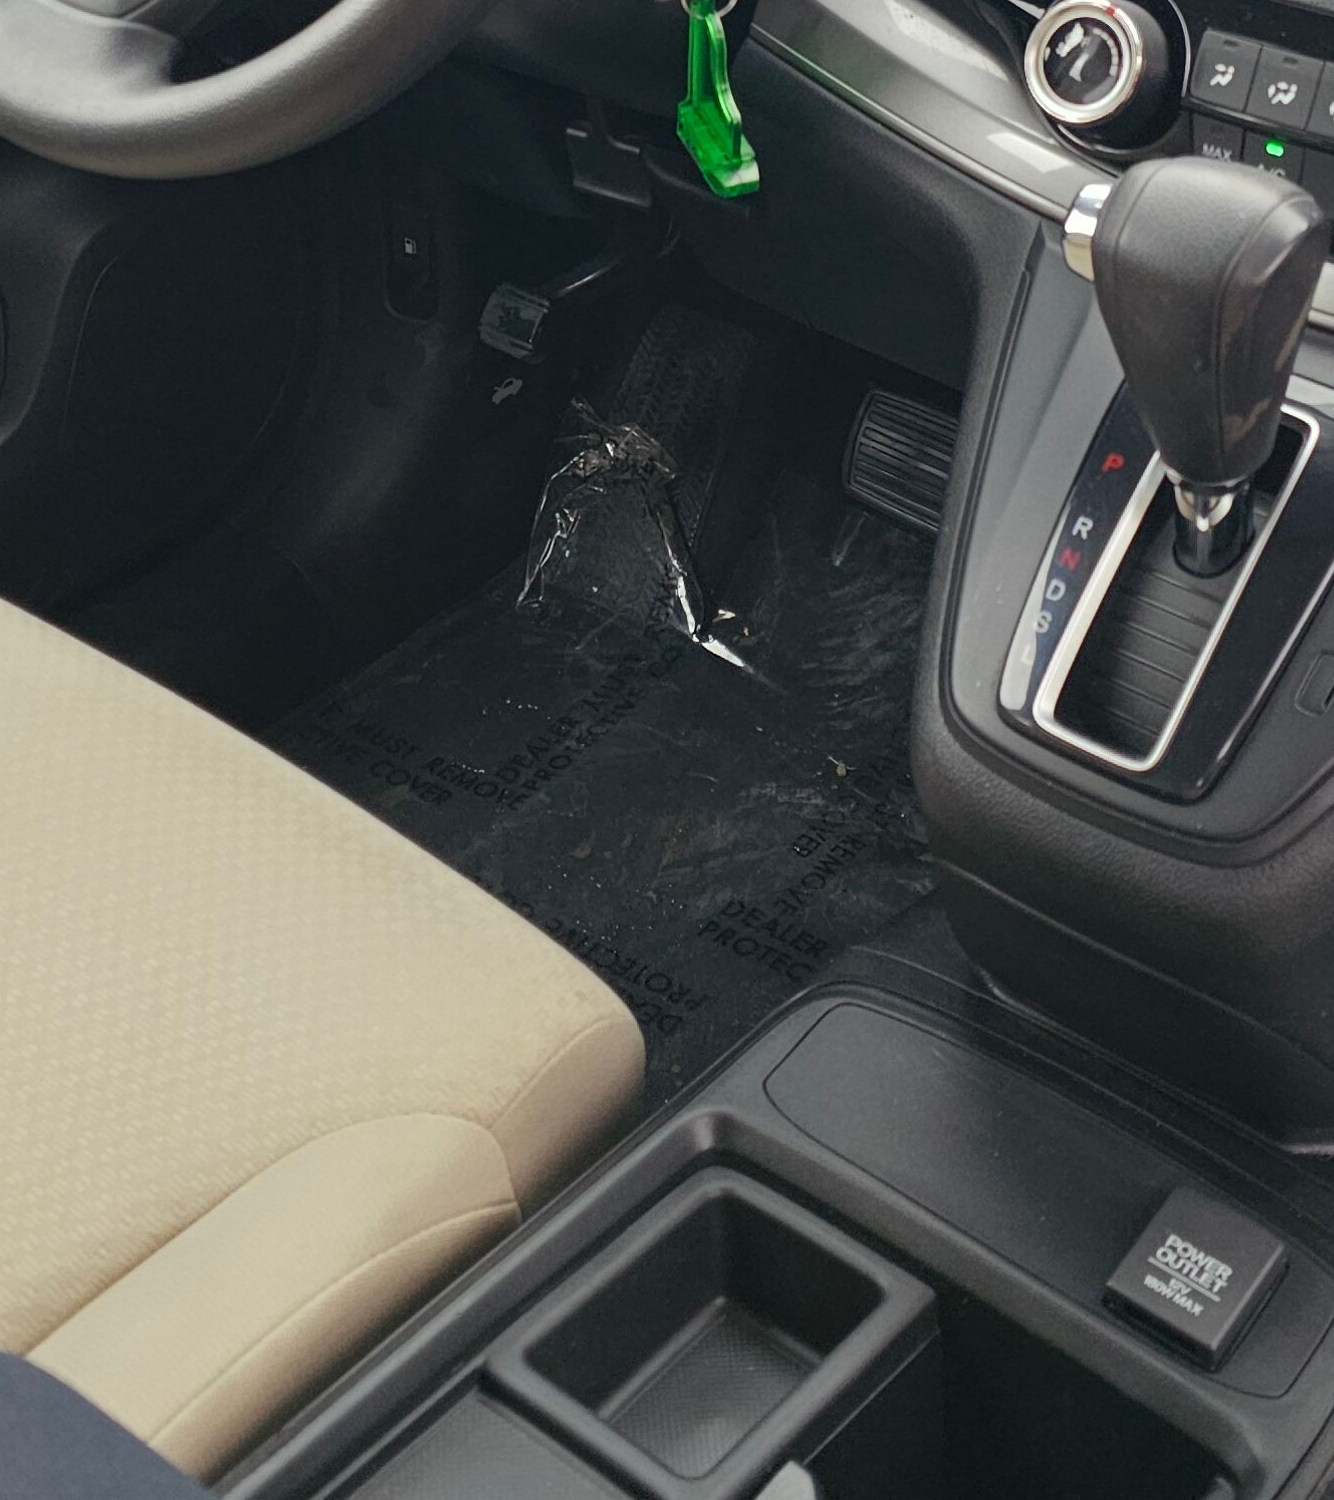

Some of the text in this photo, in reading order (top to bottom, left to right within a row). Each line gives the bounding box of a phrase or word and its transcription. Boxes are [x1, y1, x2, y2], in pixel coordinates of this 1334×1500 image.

[1202, 142, 1234, 162] MAX
[1102, 452, 1126, 473] P
[1072, 515, 1094, 540] R
[1059, 547, 1082, 571] N
[1045, 578, 1066, 601] D
[1034, 611, 1053, 634] S
[697, 920, 817, 984] PROTEC
[1165, 1234, 1233, 1281] POWER
[1156, 1247, 1228, 1293] OUTLET
[1172, 1293, 1204, 1316] MAX
